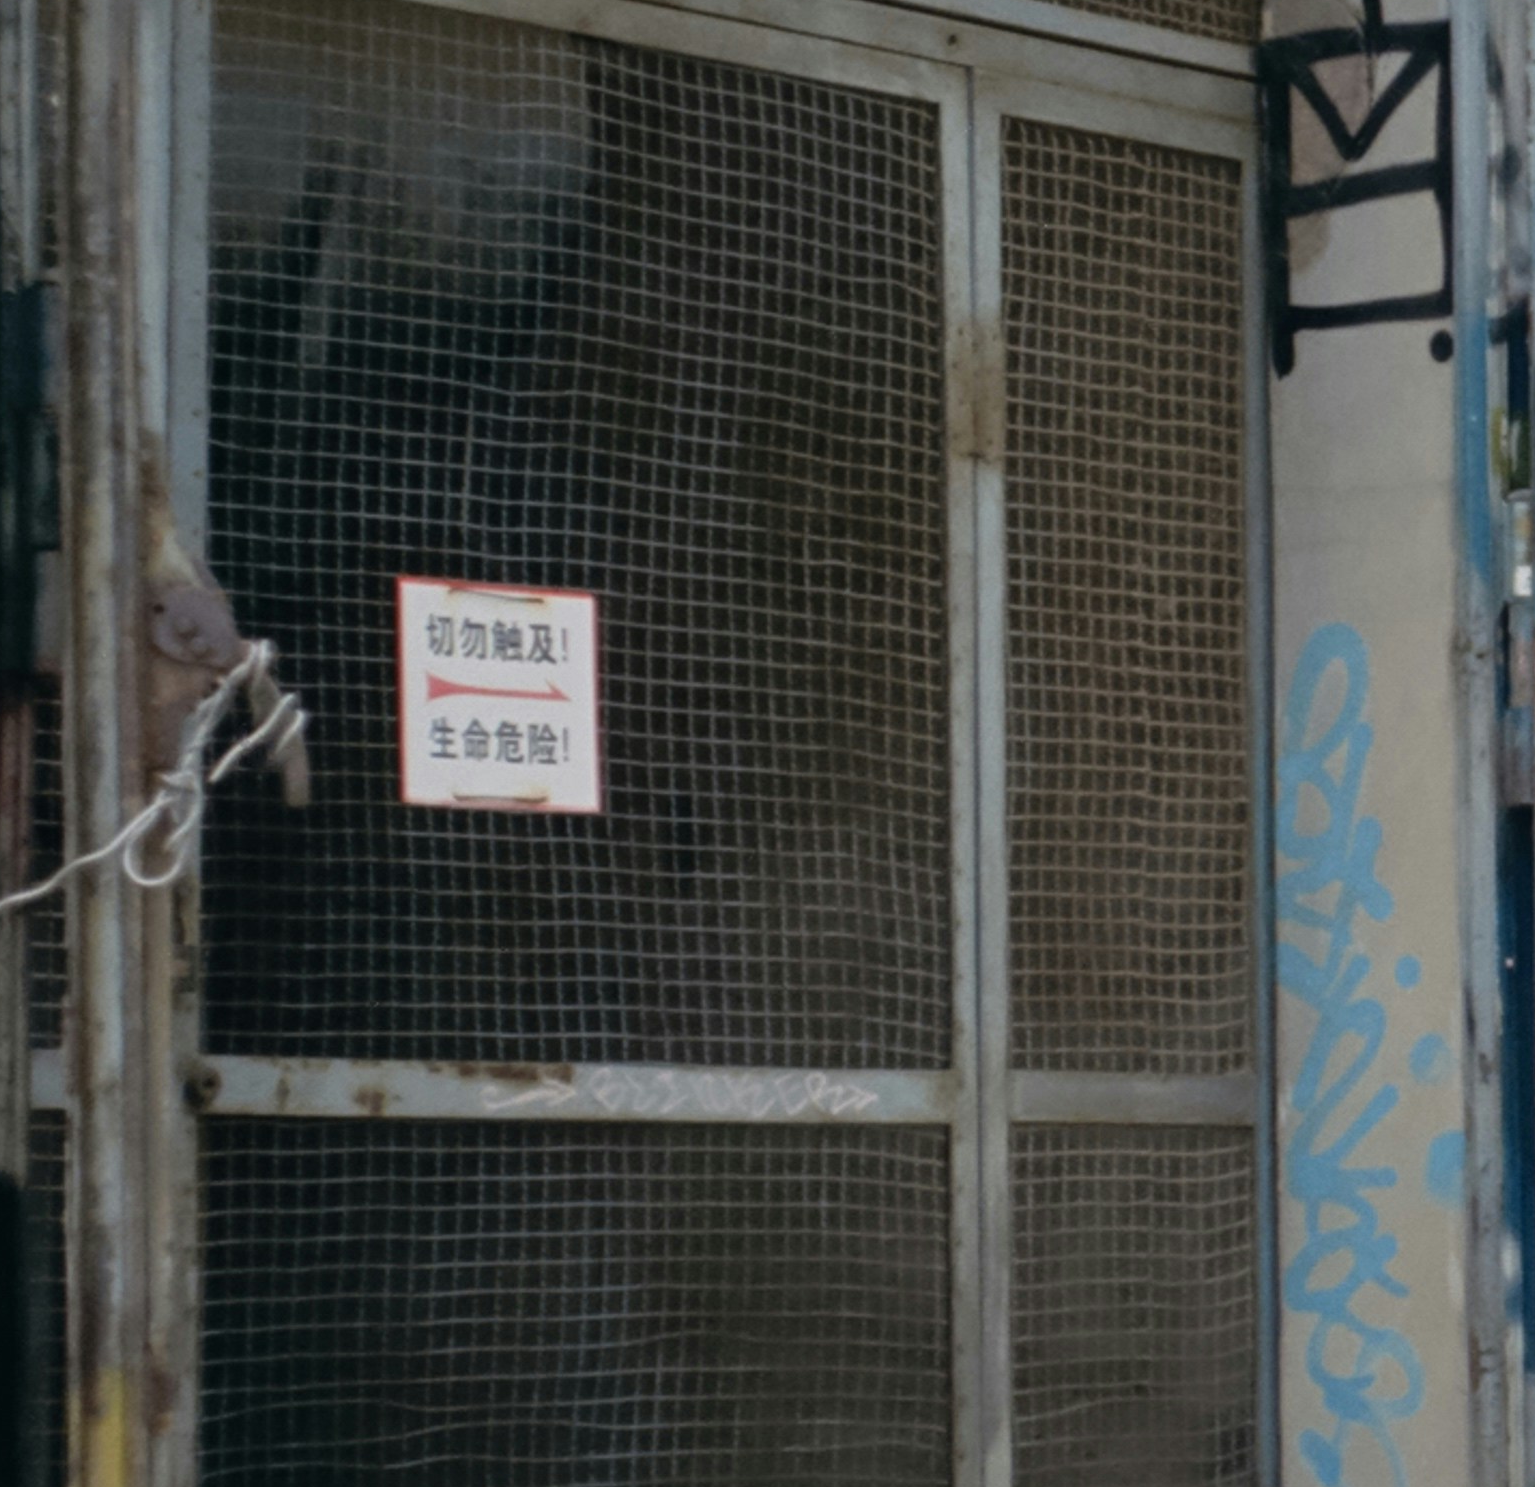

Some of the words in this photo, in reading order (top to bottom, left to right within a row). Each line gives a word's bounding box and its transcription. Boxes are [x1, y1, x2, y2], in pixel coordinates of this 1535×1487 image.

[425, 614, 569, 664] 切勿触及！
[428, 717, 569, 765] 生命危险！
